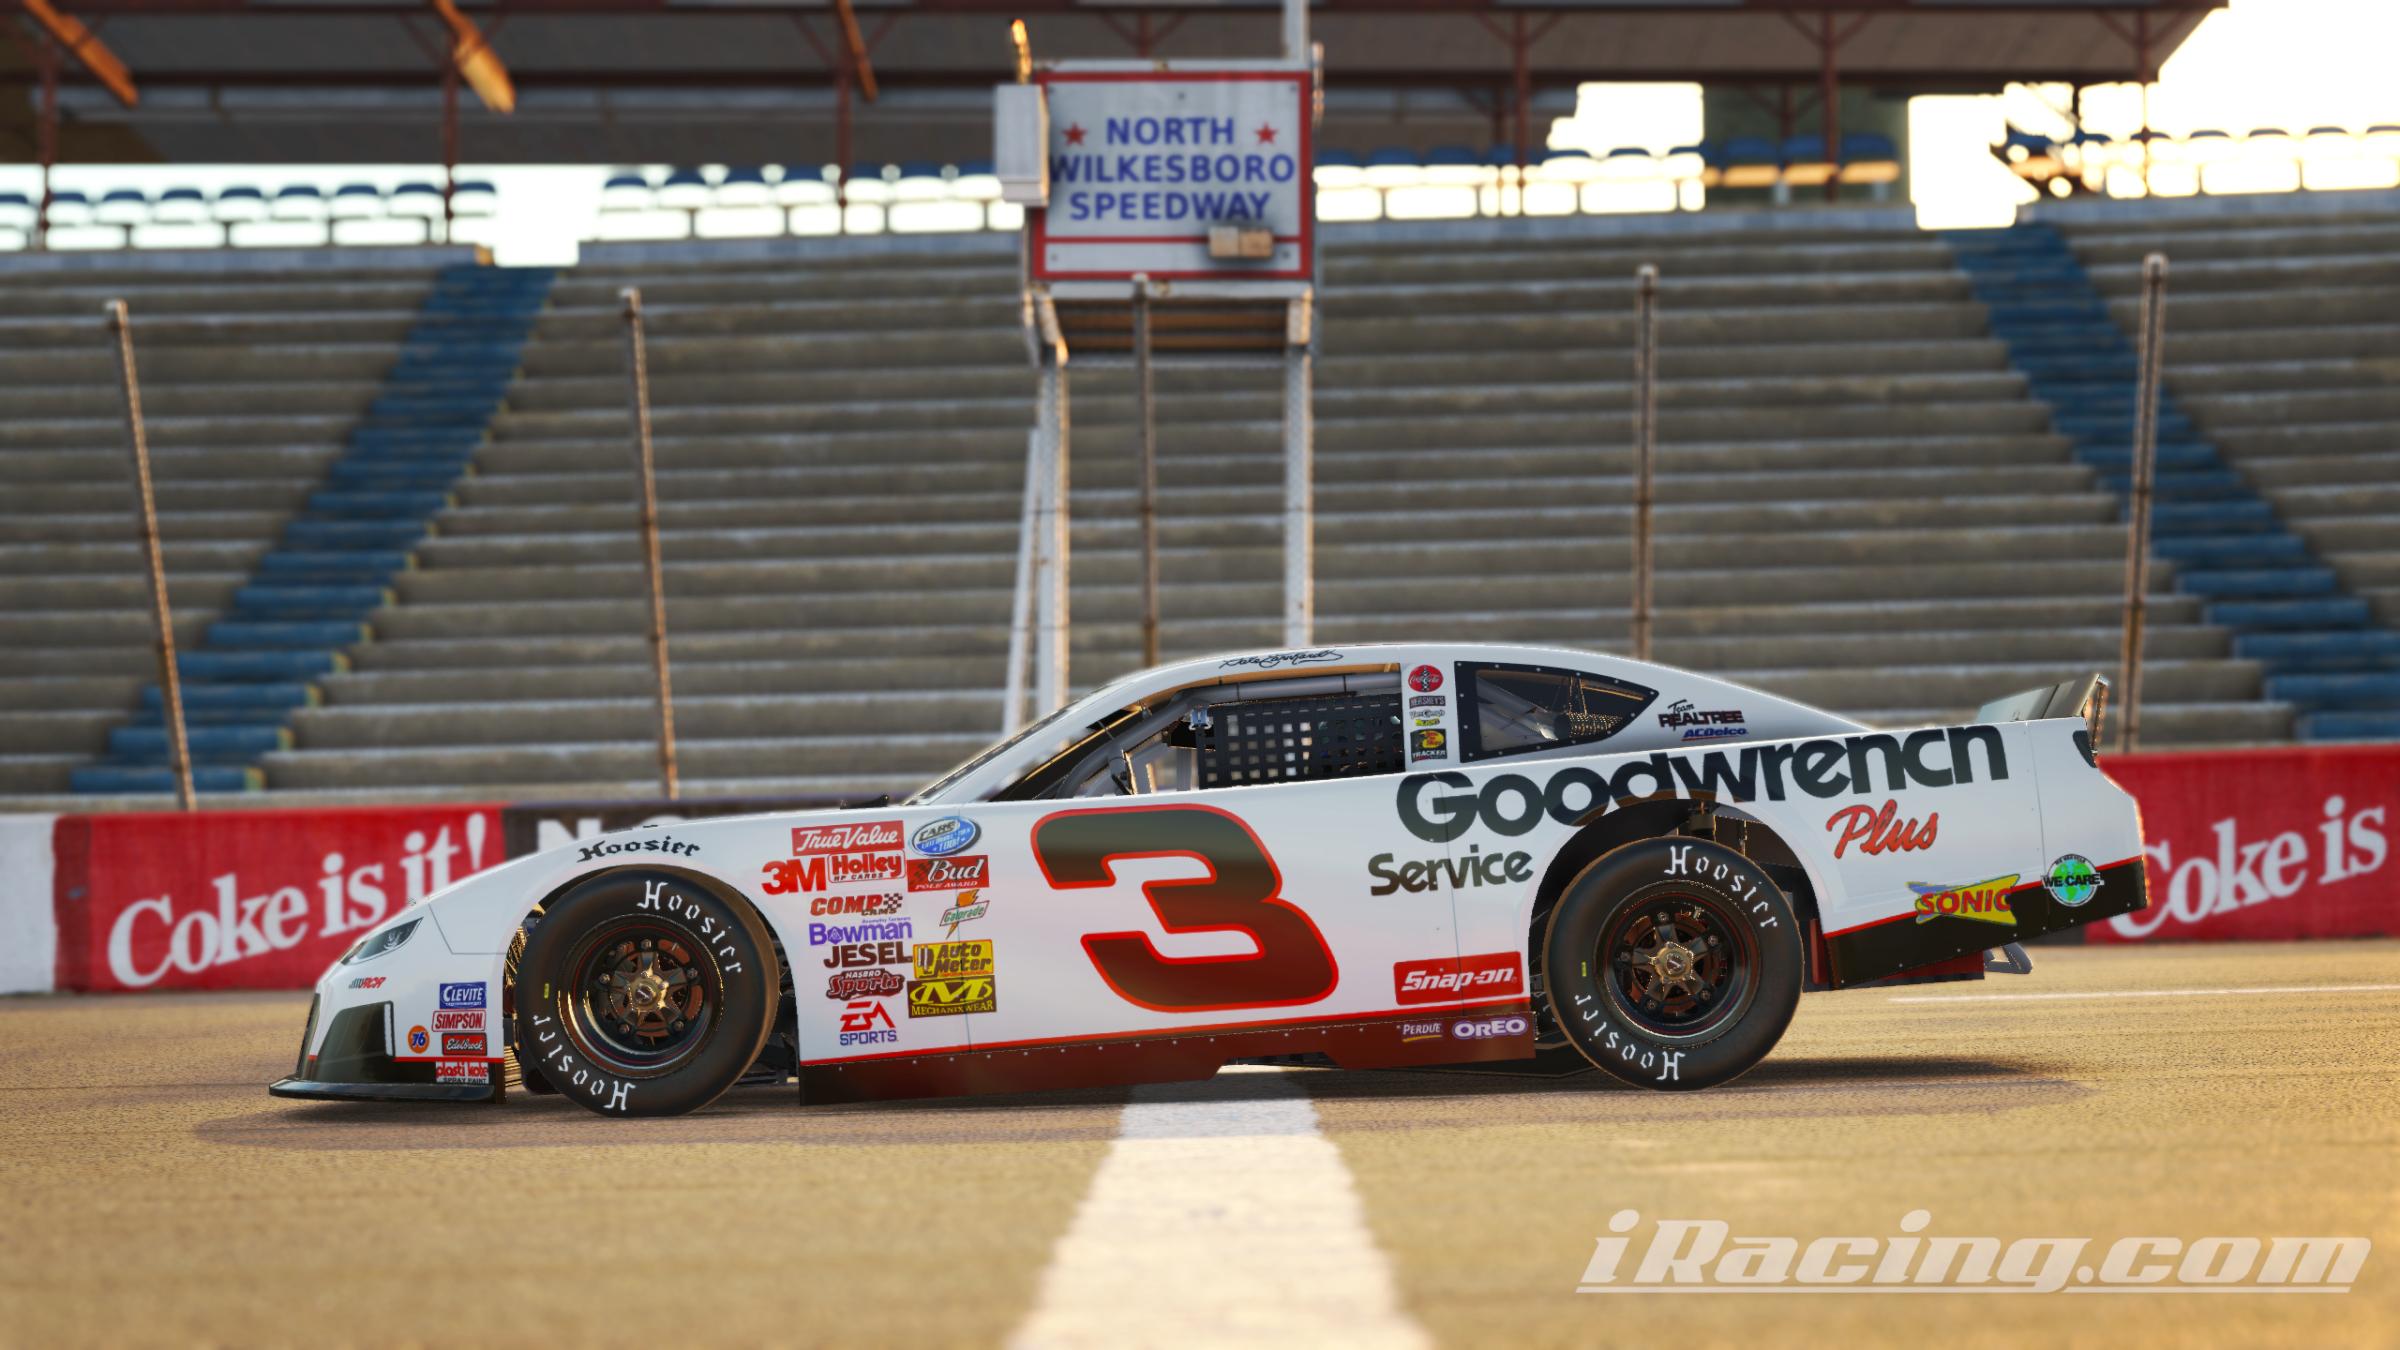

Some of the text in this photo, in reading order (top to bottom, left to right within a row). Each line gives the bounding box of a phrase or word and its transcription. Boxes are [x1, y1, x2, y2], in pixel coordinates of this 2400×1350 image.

[1106, 117, 1234, 145] NORTH
[1049, 153, 1294, 183] WILKESBORO
[1070, 191, 1270, 221] SPEEDWAY
[1658, 710, 1745, 727] REALTREE
[1683, 727, 1747, 738] ACDelco
[1826, 799, 1939, 860] Plus
[2318, 795, 2388, 885] is
[576, 836, 701, 863] Hoosier
[761, 857, 827, 895] 3M
[831, 852, 901, 877] Holley
[927, 858, 985, 882] Bud
[1368, 845, 1533, 896] Service
[1664, 845, 1778, 928] Hoosier
[2042, 873, 2101, 887] WE CARE
[108, 873, 307, 988] Coke
[319, 853, 387, 937] is
[400, 812, 486, 902] it!
[810, 893, 883, 916] COMP
[1030, 803, 1339, 1013] 3
[1919, 888, 2012, 915] SONIC
[637, 880, 742, 973] Hoosier
[823, 941, 914, 969] JESEL
[939, 943, 982, 960] Auto
[845, 970, 881, 978] HASBRO
[934, 957, 992, 978] Meter
[1401, 967, 1515, 991] Snap-on
[443, 985, 483, 1001] CLEVITE
[828, 973, 901, 997] Sports
[840, 1001, 896, 1032] EA
[911, 1000, 994, 1016] MECHANIX WEAR
[435, 1012, 483, 1030] SIMPSON
[1403, 1023, 1441, 1035] PERDUE
[1454, 1018, 1526, 1037] OREO
[411, 1032, 426, 1046] 76
[840, 1030, 897, 1046] SPORTS
